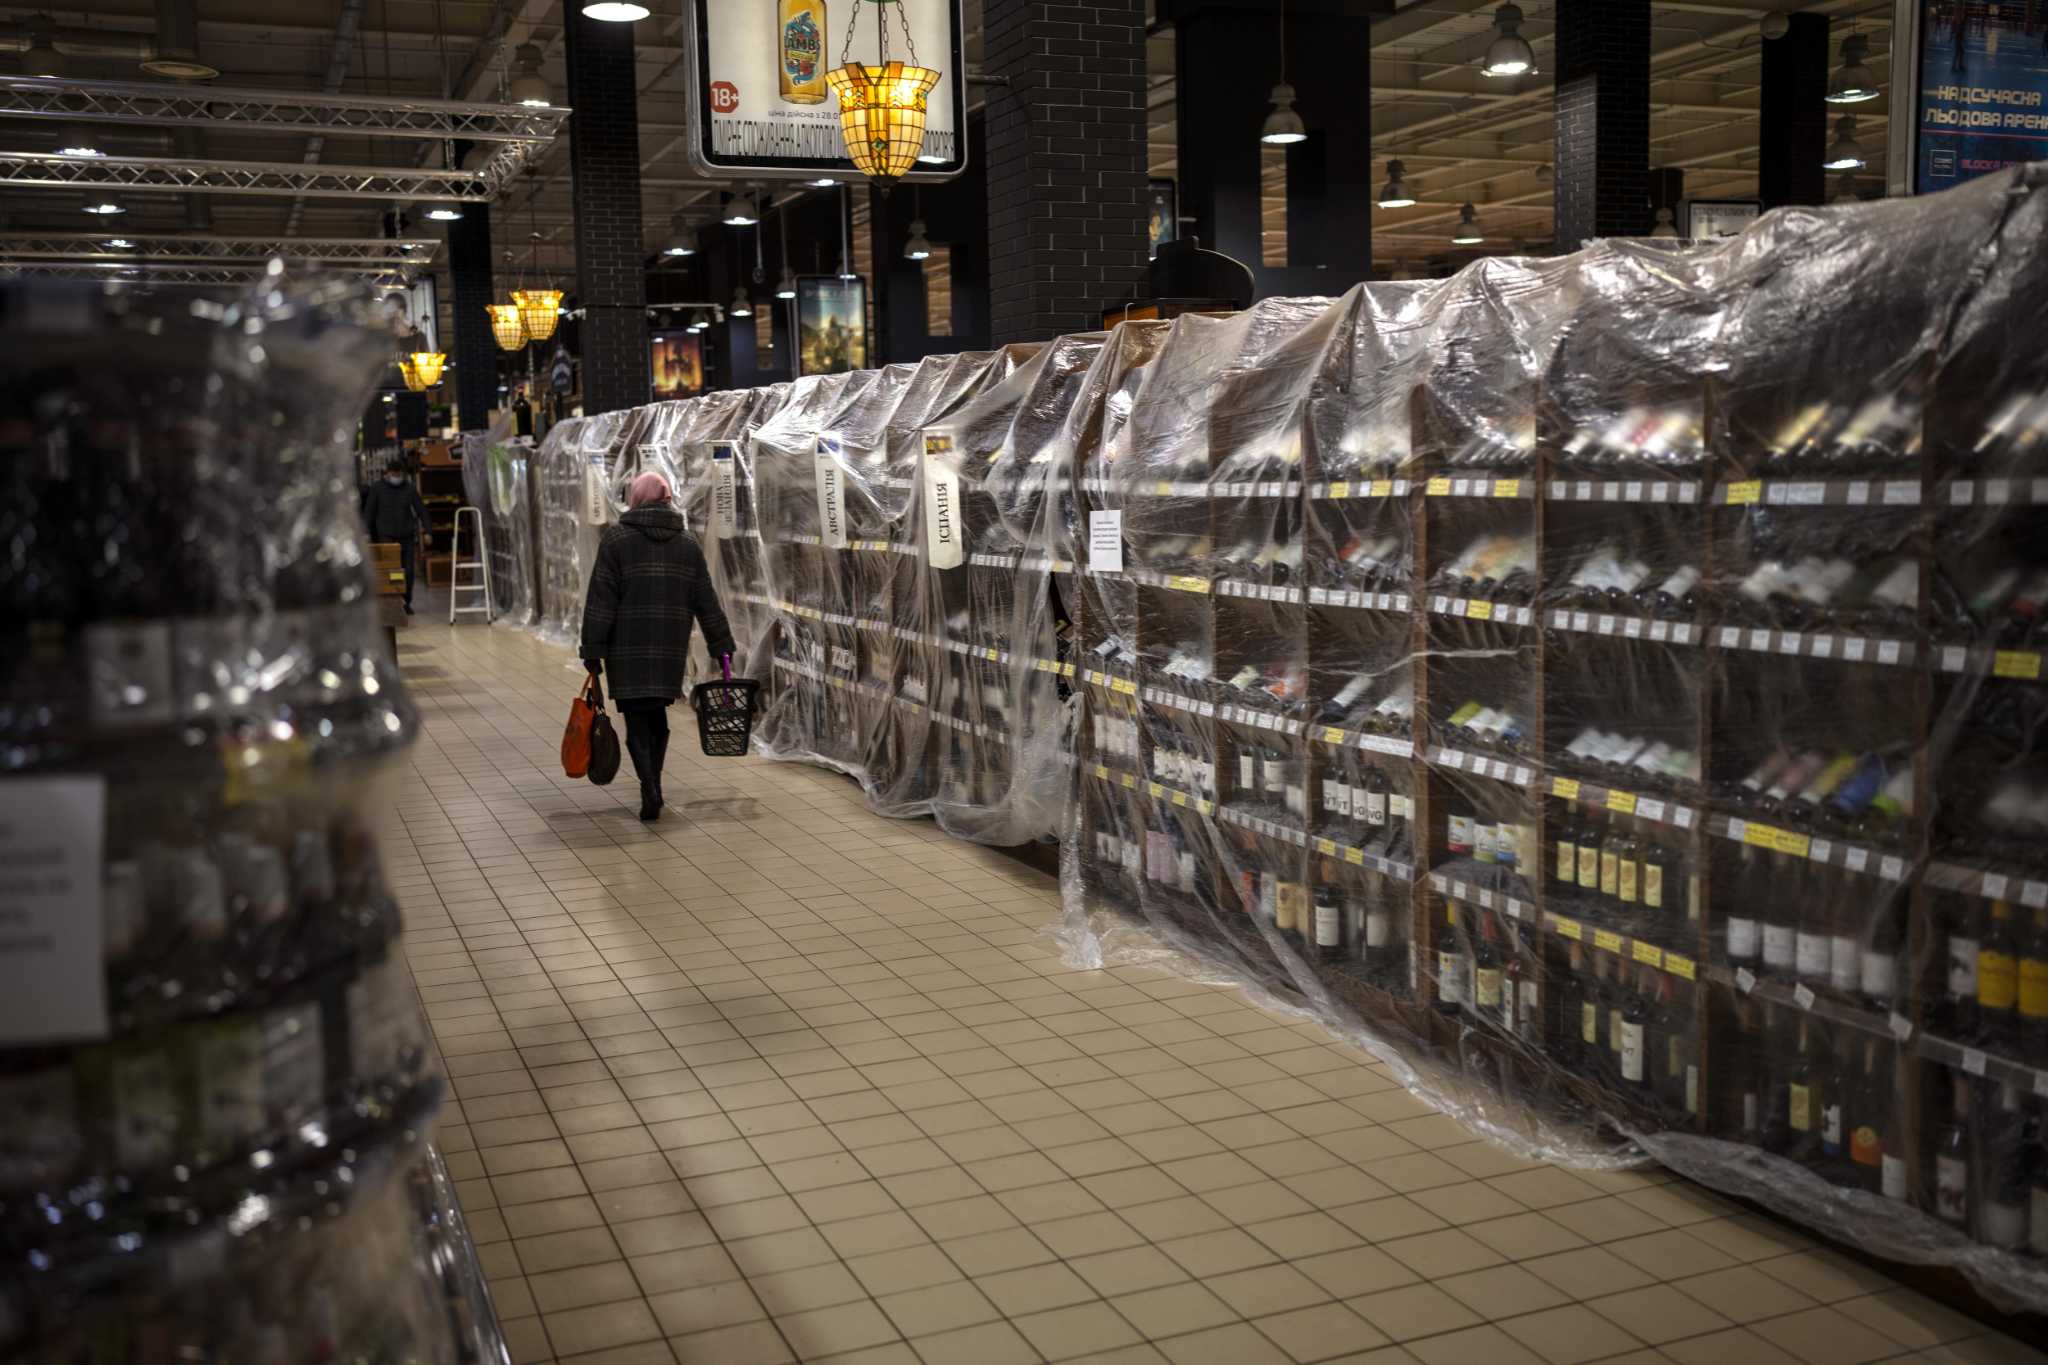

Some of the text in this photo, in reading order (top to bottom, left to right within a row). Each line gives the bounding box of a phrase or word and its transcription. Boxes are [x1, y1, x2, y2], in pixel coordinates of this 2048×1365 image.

[711, 88, 740, 107] 18+
[1937, 85, 2042, 106] НАДСУЧАСНА
[1925, 108, 2002, 128] ЛЬОДОВА
[825, 469, 839, 536] АВСТРАЛІЯ
[936, 482, 951, 544] ІСПАНІЯ
